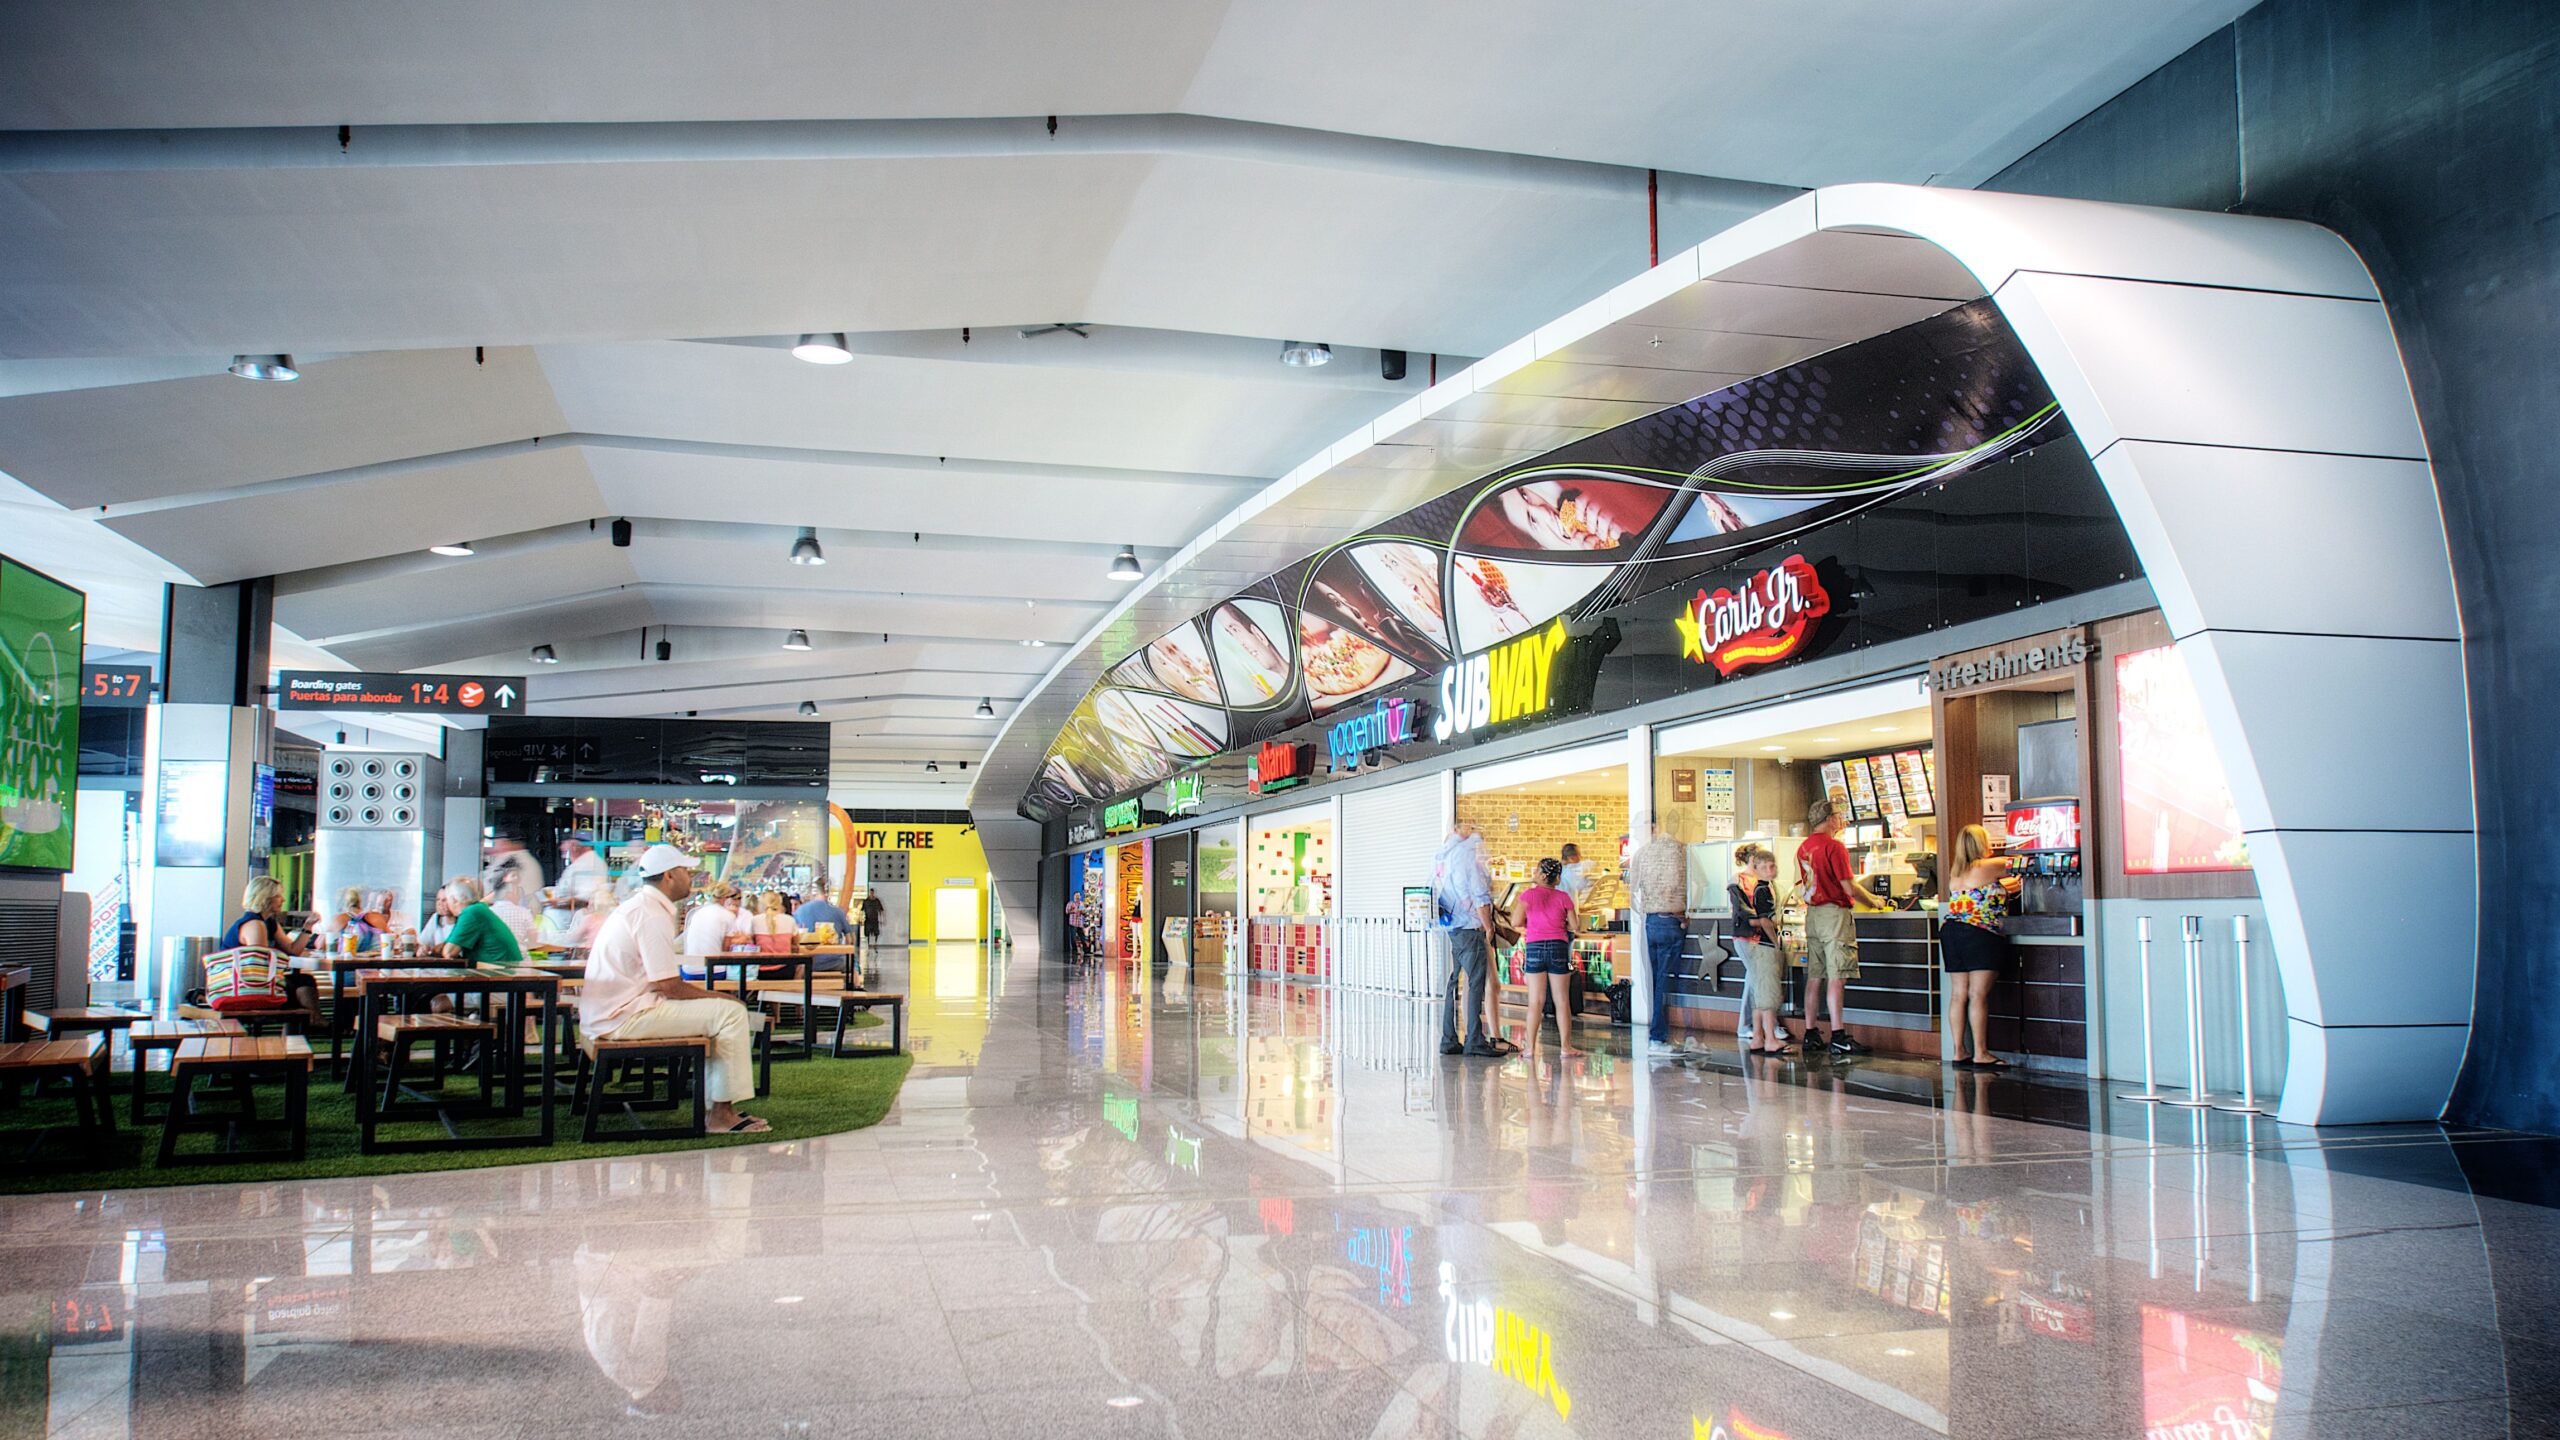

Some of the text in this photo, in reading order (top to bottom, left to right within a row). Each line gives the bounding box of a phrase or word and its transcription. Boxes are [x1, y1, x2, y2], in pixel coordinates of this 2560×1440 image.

[1698, 565, 1811, 654] Carl's Jr.
[1918, 632, 2088, 695] refreshments
[94, 673, 141, 697] 5 to 7
[112, 687, 121, 696] a
[291, 679, 362, 693] Boarding gates
[1434, 616, 1567, 745] SUBWAY
[290, 690, 403, 704] Puertas para abordar
[410, 682, 449, 704] 1 to 4
[423, 695, 431, 704] a
[1257, 740, 1296, 784] sbarro
[856, 831, 934, 849] UTY FREE
